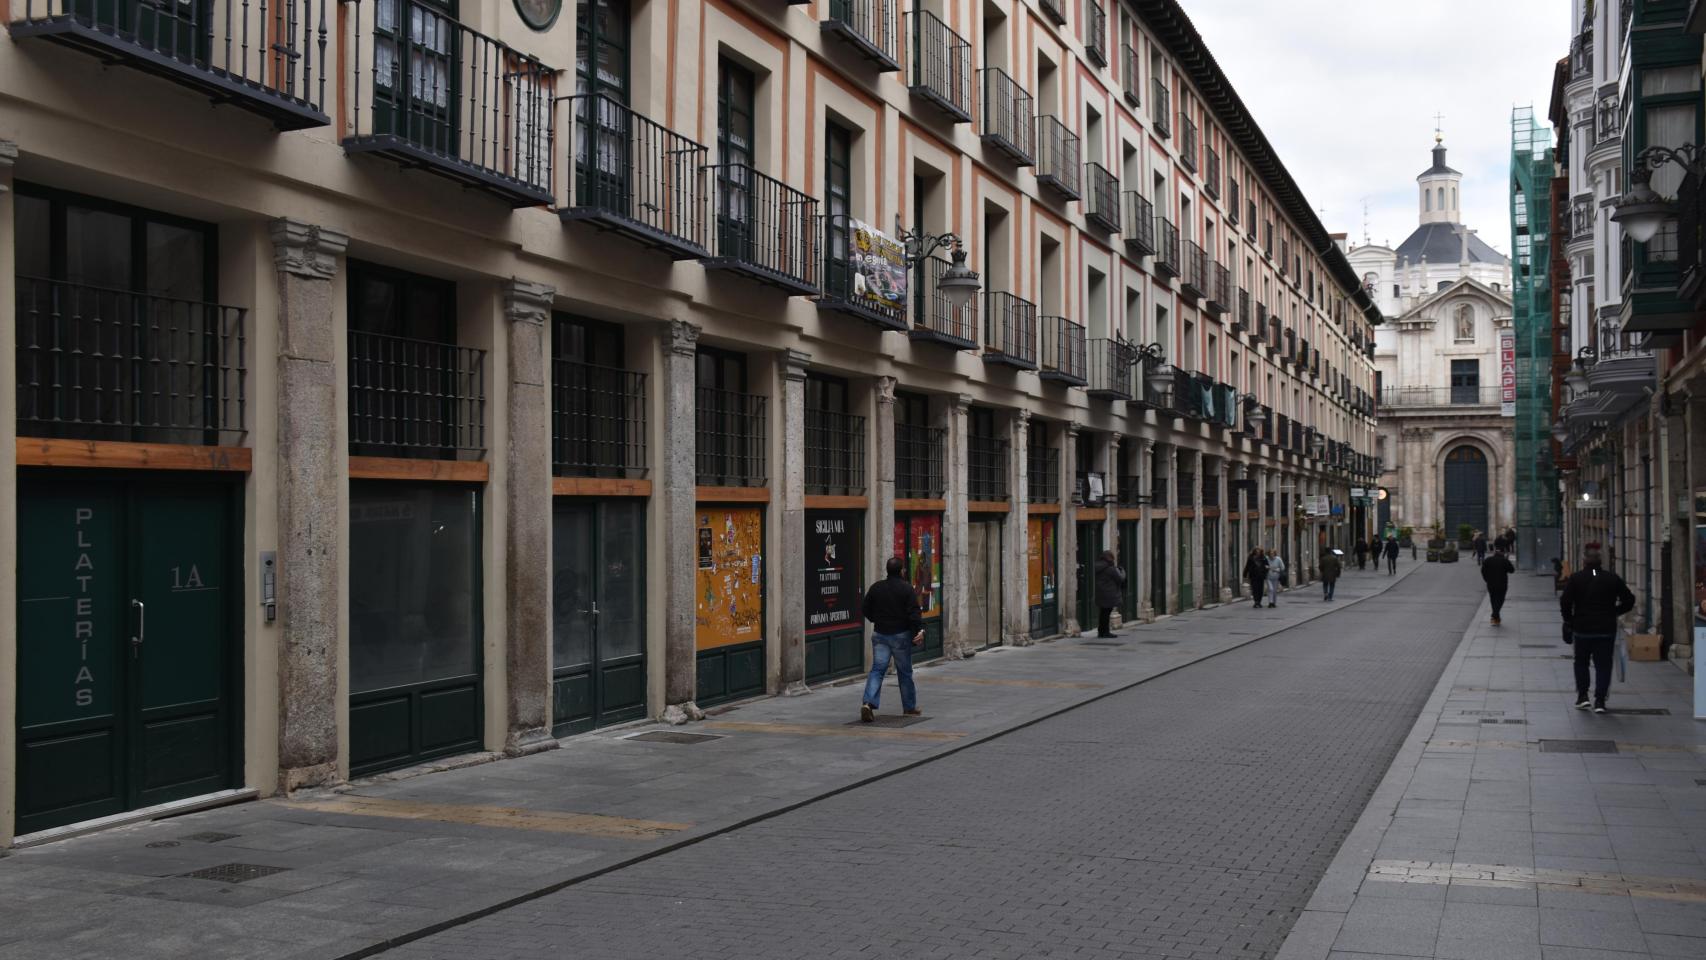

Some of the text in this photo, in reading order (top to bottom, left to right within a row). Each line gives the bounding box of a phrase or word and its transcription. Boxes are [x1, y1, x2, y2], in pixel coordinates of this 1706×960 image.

[1502, 339, 1514, 399] BLAPE
[208, 449, 230, 470] 1A
[170, 563, 205, 589] 1A
[75, 508, 94, 707] PLATERÍAS
